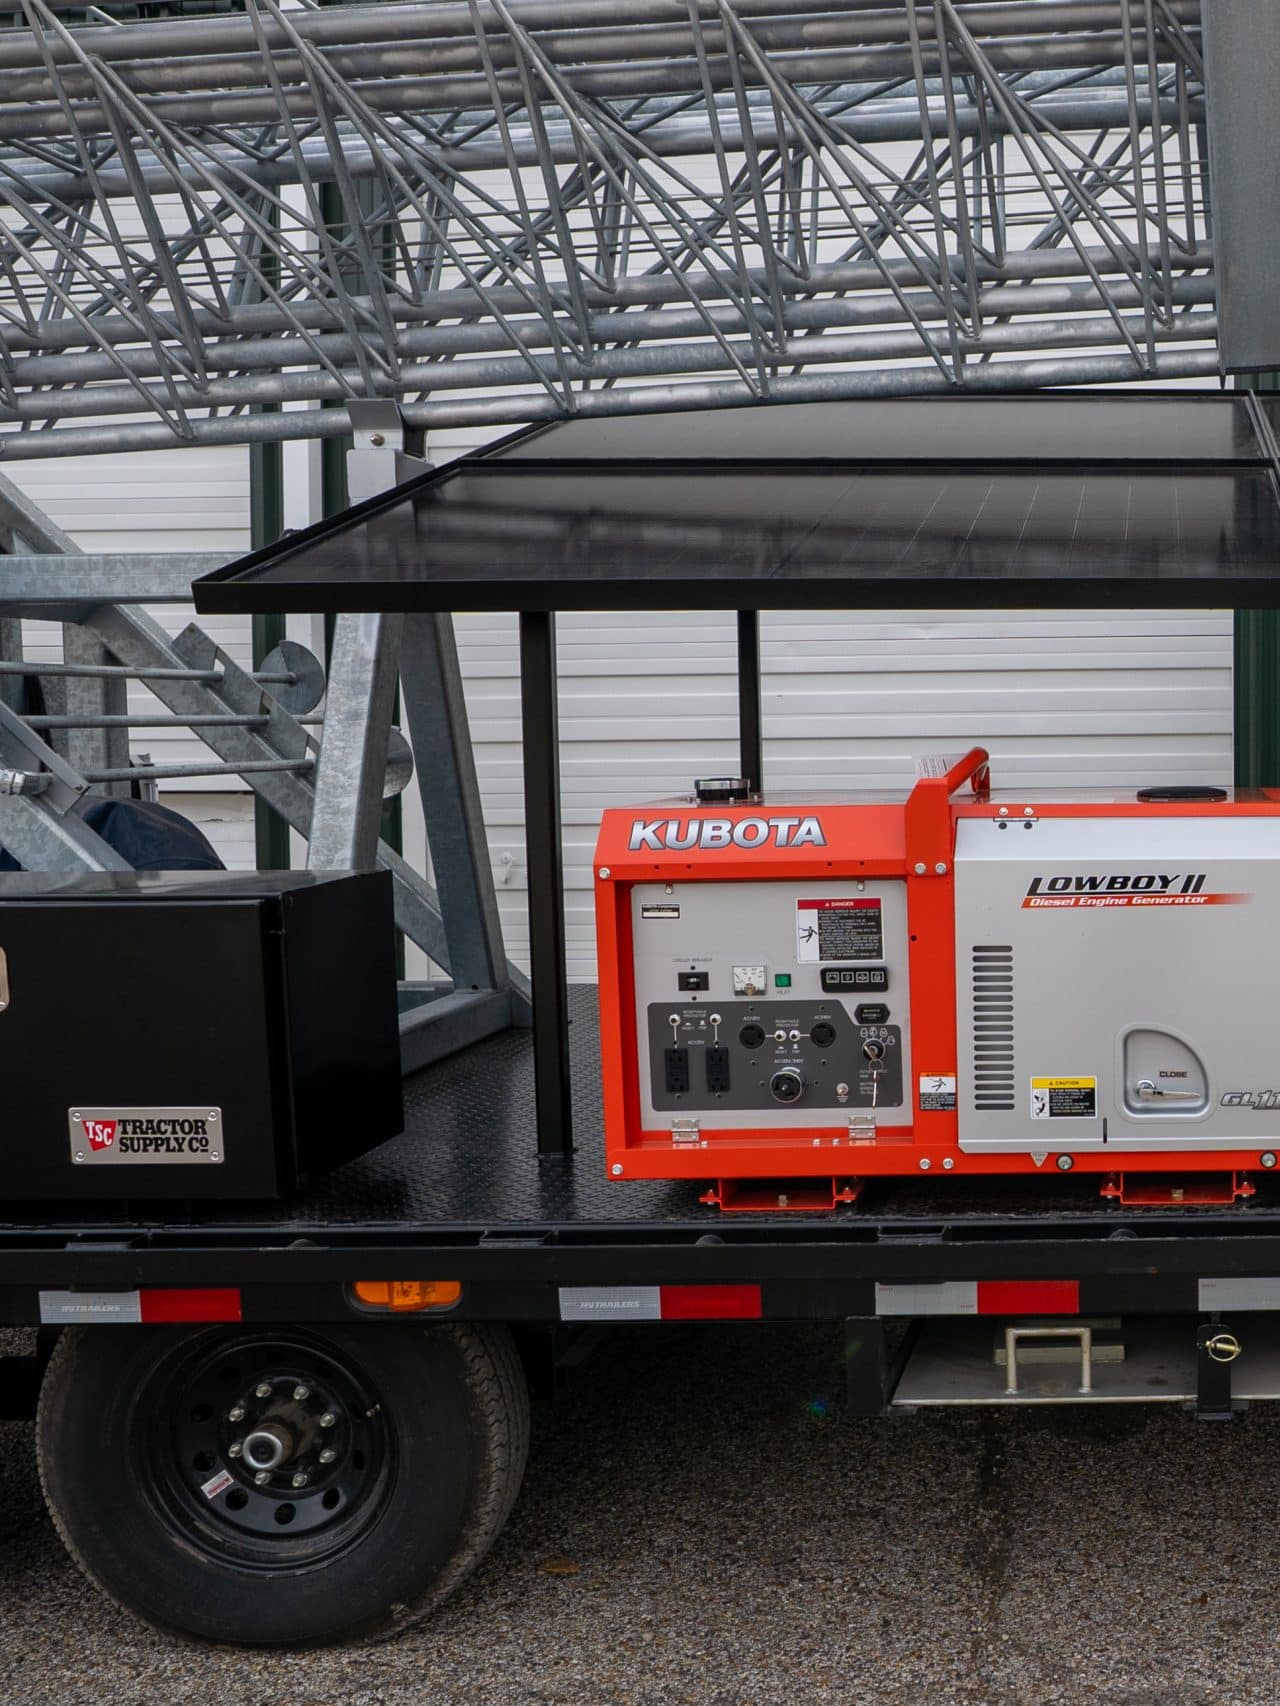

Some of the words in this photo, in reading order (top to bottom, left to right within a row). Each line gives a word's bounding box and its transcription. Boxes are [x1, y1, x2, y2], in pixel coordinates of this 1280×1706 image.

[628, 817, 827, 850] KUBOTA
[1026, 874, 1181, 896] LOWBOY
[1029, 897, 1076, 907] Diesel
[1078, 896, 1128, 907] Engine
[1131, 895, 1208, 905] Generator
[86, 1121, 113, 1146] TSC
[118, 1119, 208, 1135] TRACTOR
[119, 1136, 186, 1153] SUPPLY
